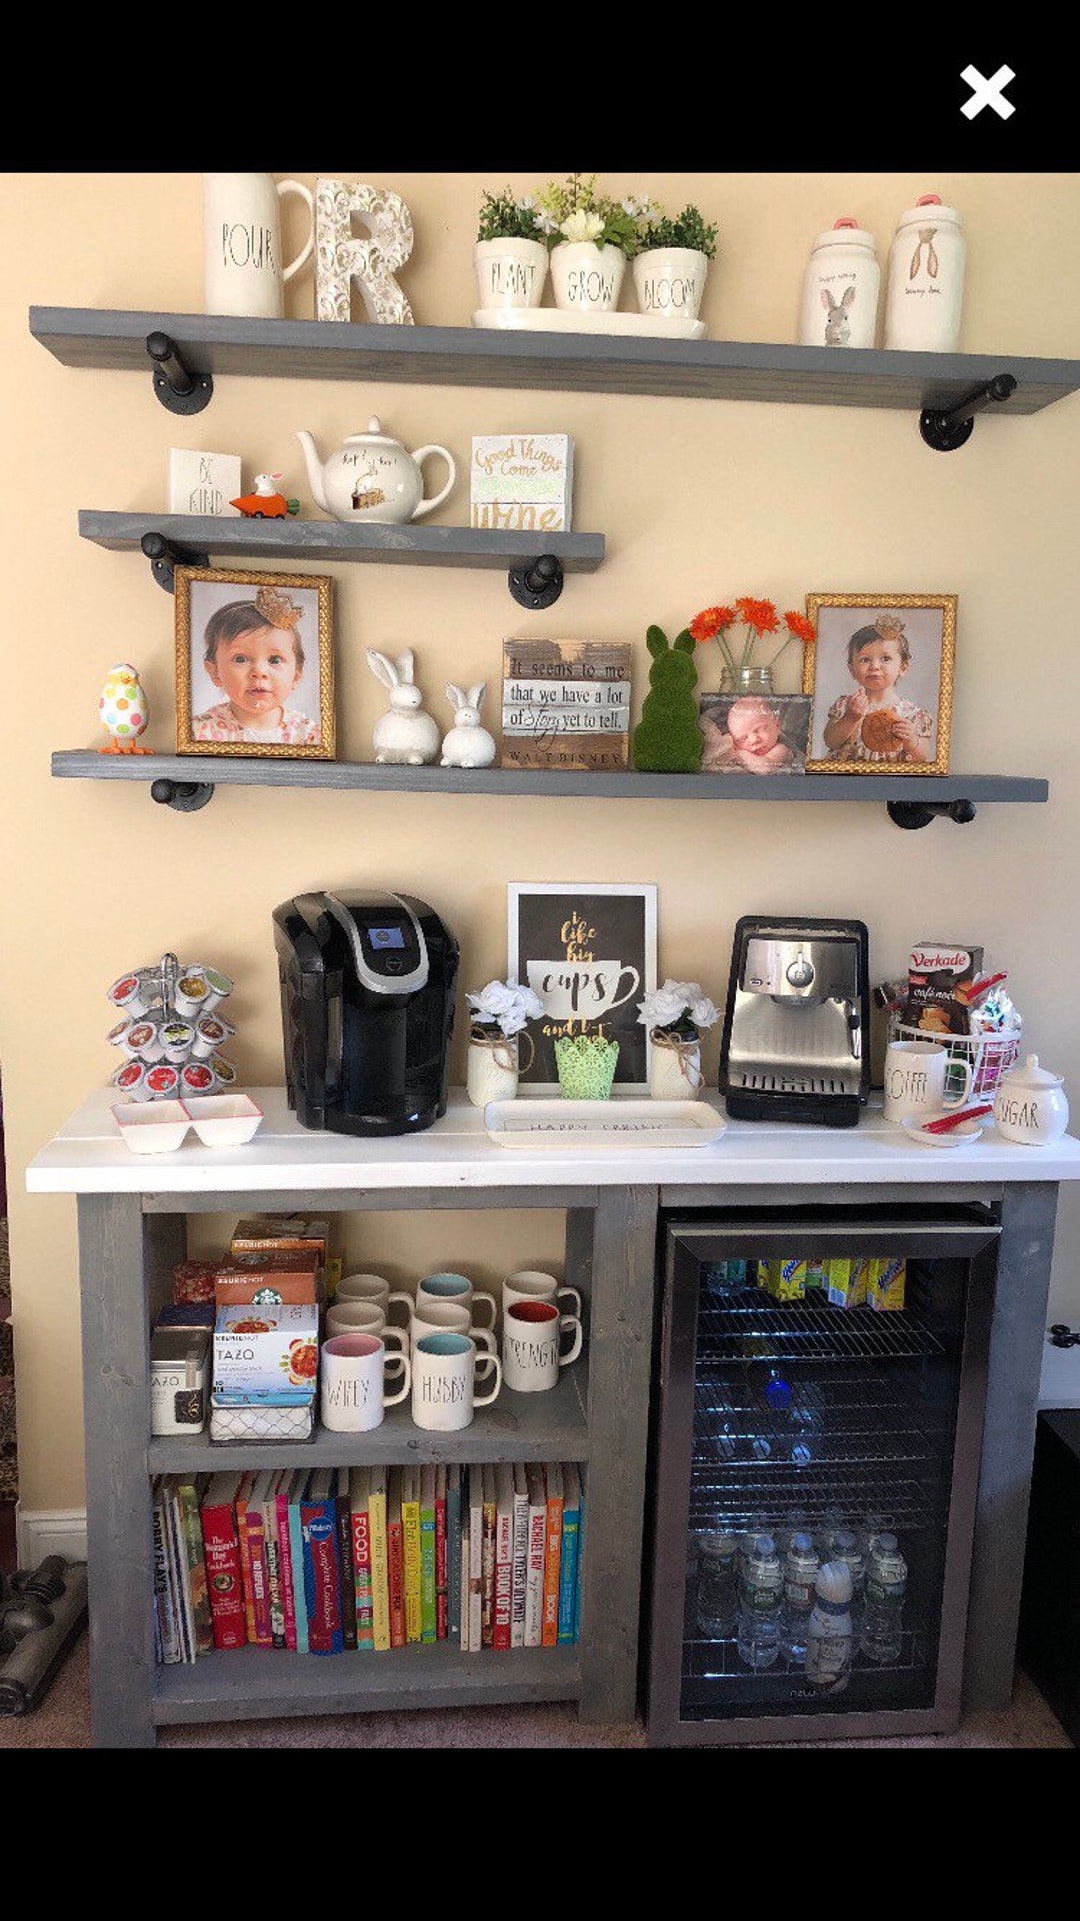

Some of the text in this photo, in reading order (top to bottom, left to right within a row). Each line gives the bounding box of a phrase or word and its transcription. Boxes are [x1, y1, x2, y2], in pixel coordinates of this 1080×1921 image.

[221, 222, 276, 275] POUR
[316, 177, 415, 326] R
[491, 263, 536, 296] PLANT
[567, 271, 616, 302] GROW
[644, 279, 696, 310] BLOOM
[199, 457, 214, 485] BE
[475, 439, 562, 476] Good Things
[500, 461, 538, 477] Come
[188, 488, 223, 515] KIND
[510, 658, 625, 679] It seems to me
[510, 684, 624, 704] that we have a lot
[510, 709, 525, 725] of
[562, 712, 581, 731] yet
[584, 712, 596, 728] to
[600, 712, 622, 729] tell.
[509, 751, 623, 764] WALT DISNEY
[561, 921, 597, 944] like
[566, 941, 596, 968] big
[910, 952, 967, 967] Verkade
[541, 972, 617, 1012] cups
[542, 1014, 577, 1038] and
[998, 1096, 1040, 1130] SUGAR
[216, 1348, 255, 1360] TAZO
[150, 1376, 180, 1387] AZO
[327, 1376, 370, 1408] WIFEY
[422, 1374, 467, 1404] HUBBY
[355, 1516, 368, 1562] FOOD
[530, 1514, 545, 1553] RACHAEL
[549, 1534, 558, 1551] BIG
[514, 1554, 527, 1587] TYLER'S
[530, 1554, 545, 1571] RAY
[318, 1541, 335, 1630] Complete Cookbook
[496, 1565, 512, 1595] BOOK
[495, 1597, 511, 1611] OF
[545, 1594, 557, 1624] BOOK
[496, 1613, 511, 1625] 10
